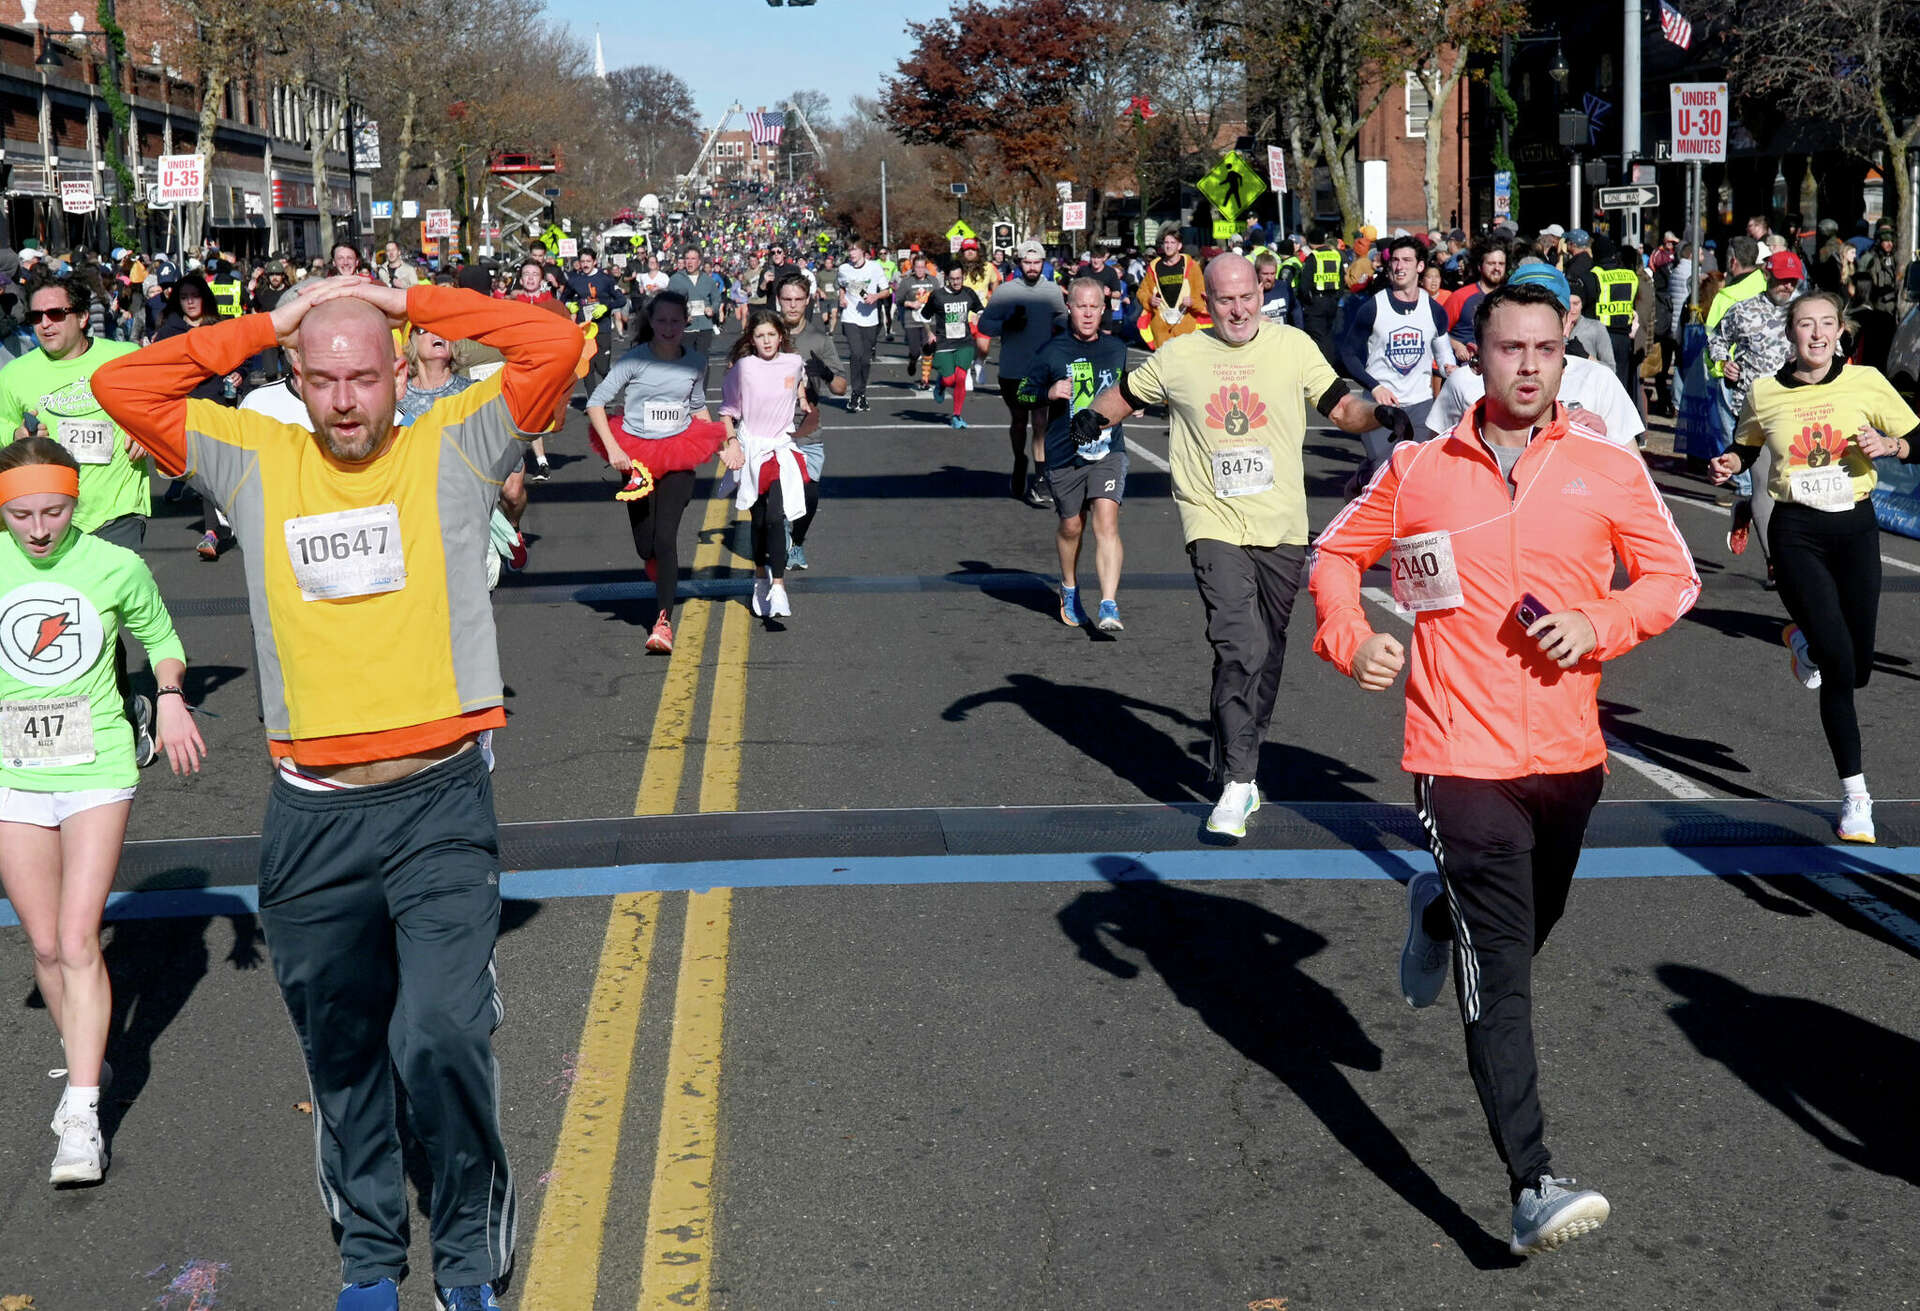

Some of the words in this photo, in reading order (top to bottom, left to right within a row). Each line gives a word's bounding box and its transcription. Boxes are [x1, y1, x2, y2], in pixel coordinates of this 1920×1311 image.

[1682, 91, 1717, 106] UNDER
[1678, 109, 1722, 136] U-30
[1677, 139, 1721, 154] MINUTES
[167, 160, 195, 169] UNDER
[163, 171, 199, 187] U-35
[162, 188, 199, 198] MINUTES
[1607, 193, 1620, 202] ONE
[1626, 192, 1640, 202] WAY
[944, 301, 968, 313] EIGHT
[651, 409, 679, 421] 11010
[69, 429, 103, 444] 2191
[1221, 458, 1264, 477] 8475
[1801, 476, 1843, 496] 8476
[296, 526, 389, 565] 10647
[1392, 552, 1439, 581] 2140
[24, 715, 65, 738] 417
